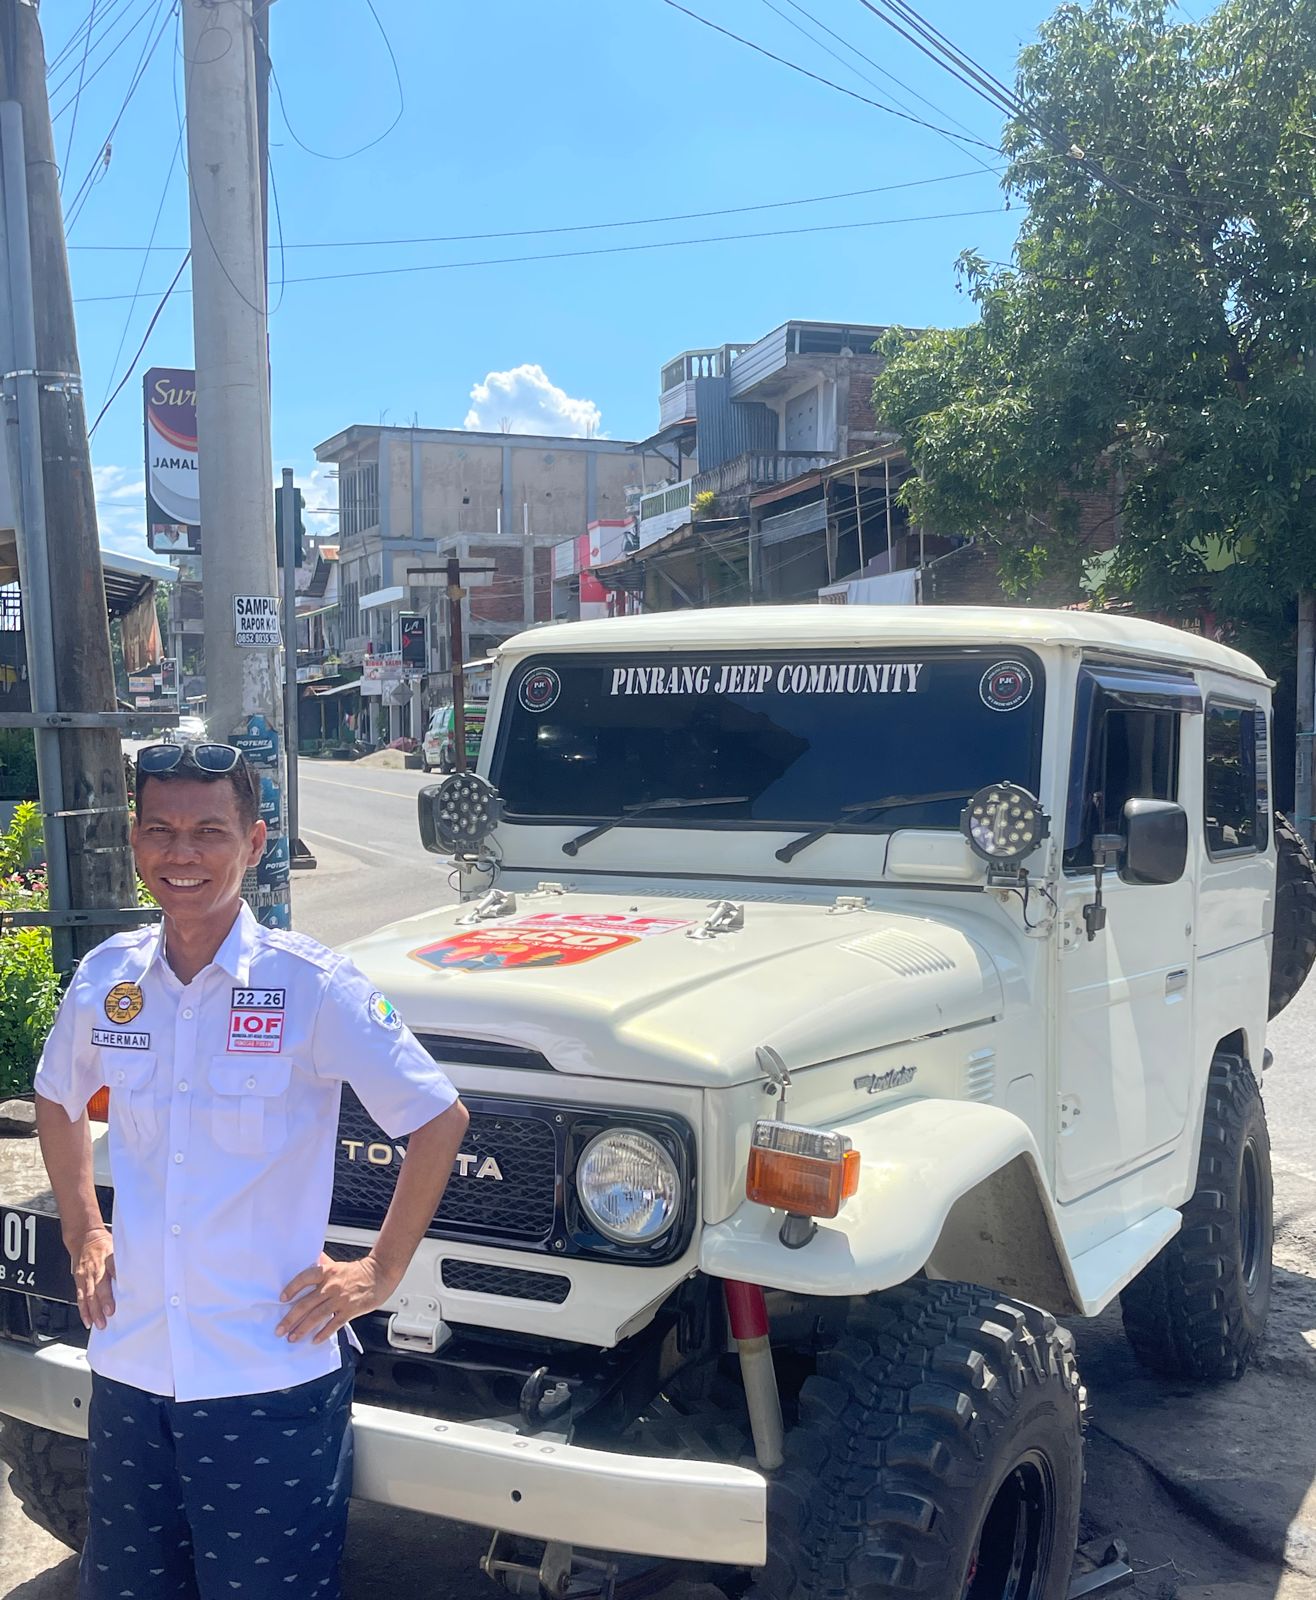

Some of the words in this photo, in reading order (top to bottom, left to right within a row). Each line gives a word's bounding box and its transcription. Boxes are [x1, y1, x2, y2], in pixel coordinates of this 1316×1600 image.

[152, 379, 197, 406] Sur
[153, 457, 198, 470] JAMAL
[241, 617, 265, 631] RAPOR
[610, 666, 711, 695] PINRANG
[714, 665, 773, 694] JEEP
[777, 664, 923, 694] COMMUNITY
[528, 913, 689, 925] IOF
[236, 992, 281, 1005] 22.26
[233, 1016, 281, 1033] IOF
[94, 1032, 147, 1047] H.HERMAN
[341, 1140, 503, 1181] TOTA
[4, 1212, 36, 1265] 01
[17, 1269, 35, 1286] 24
